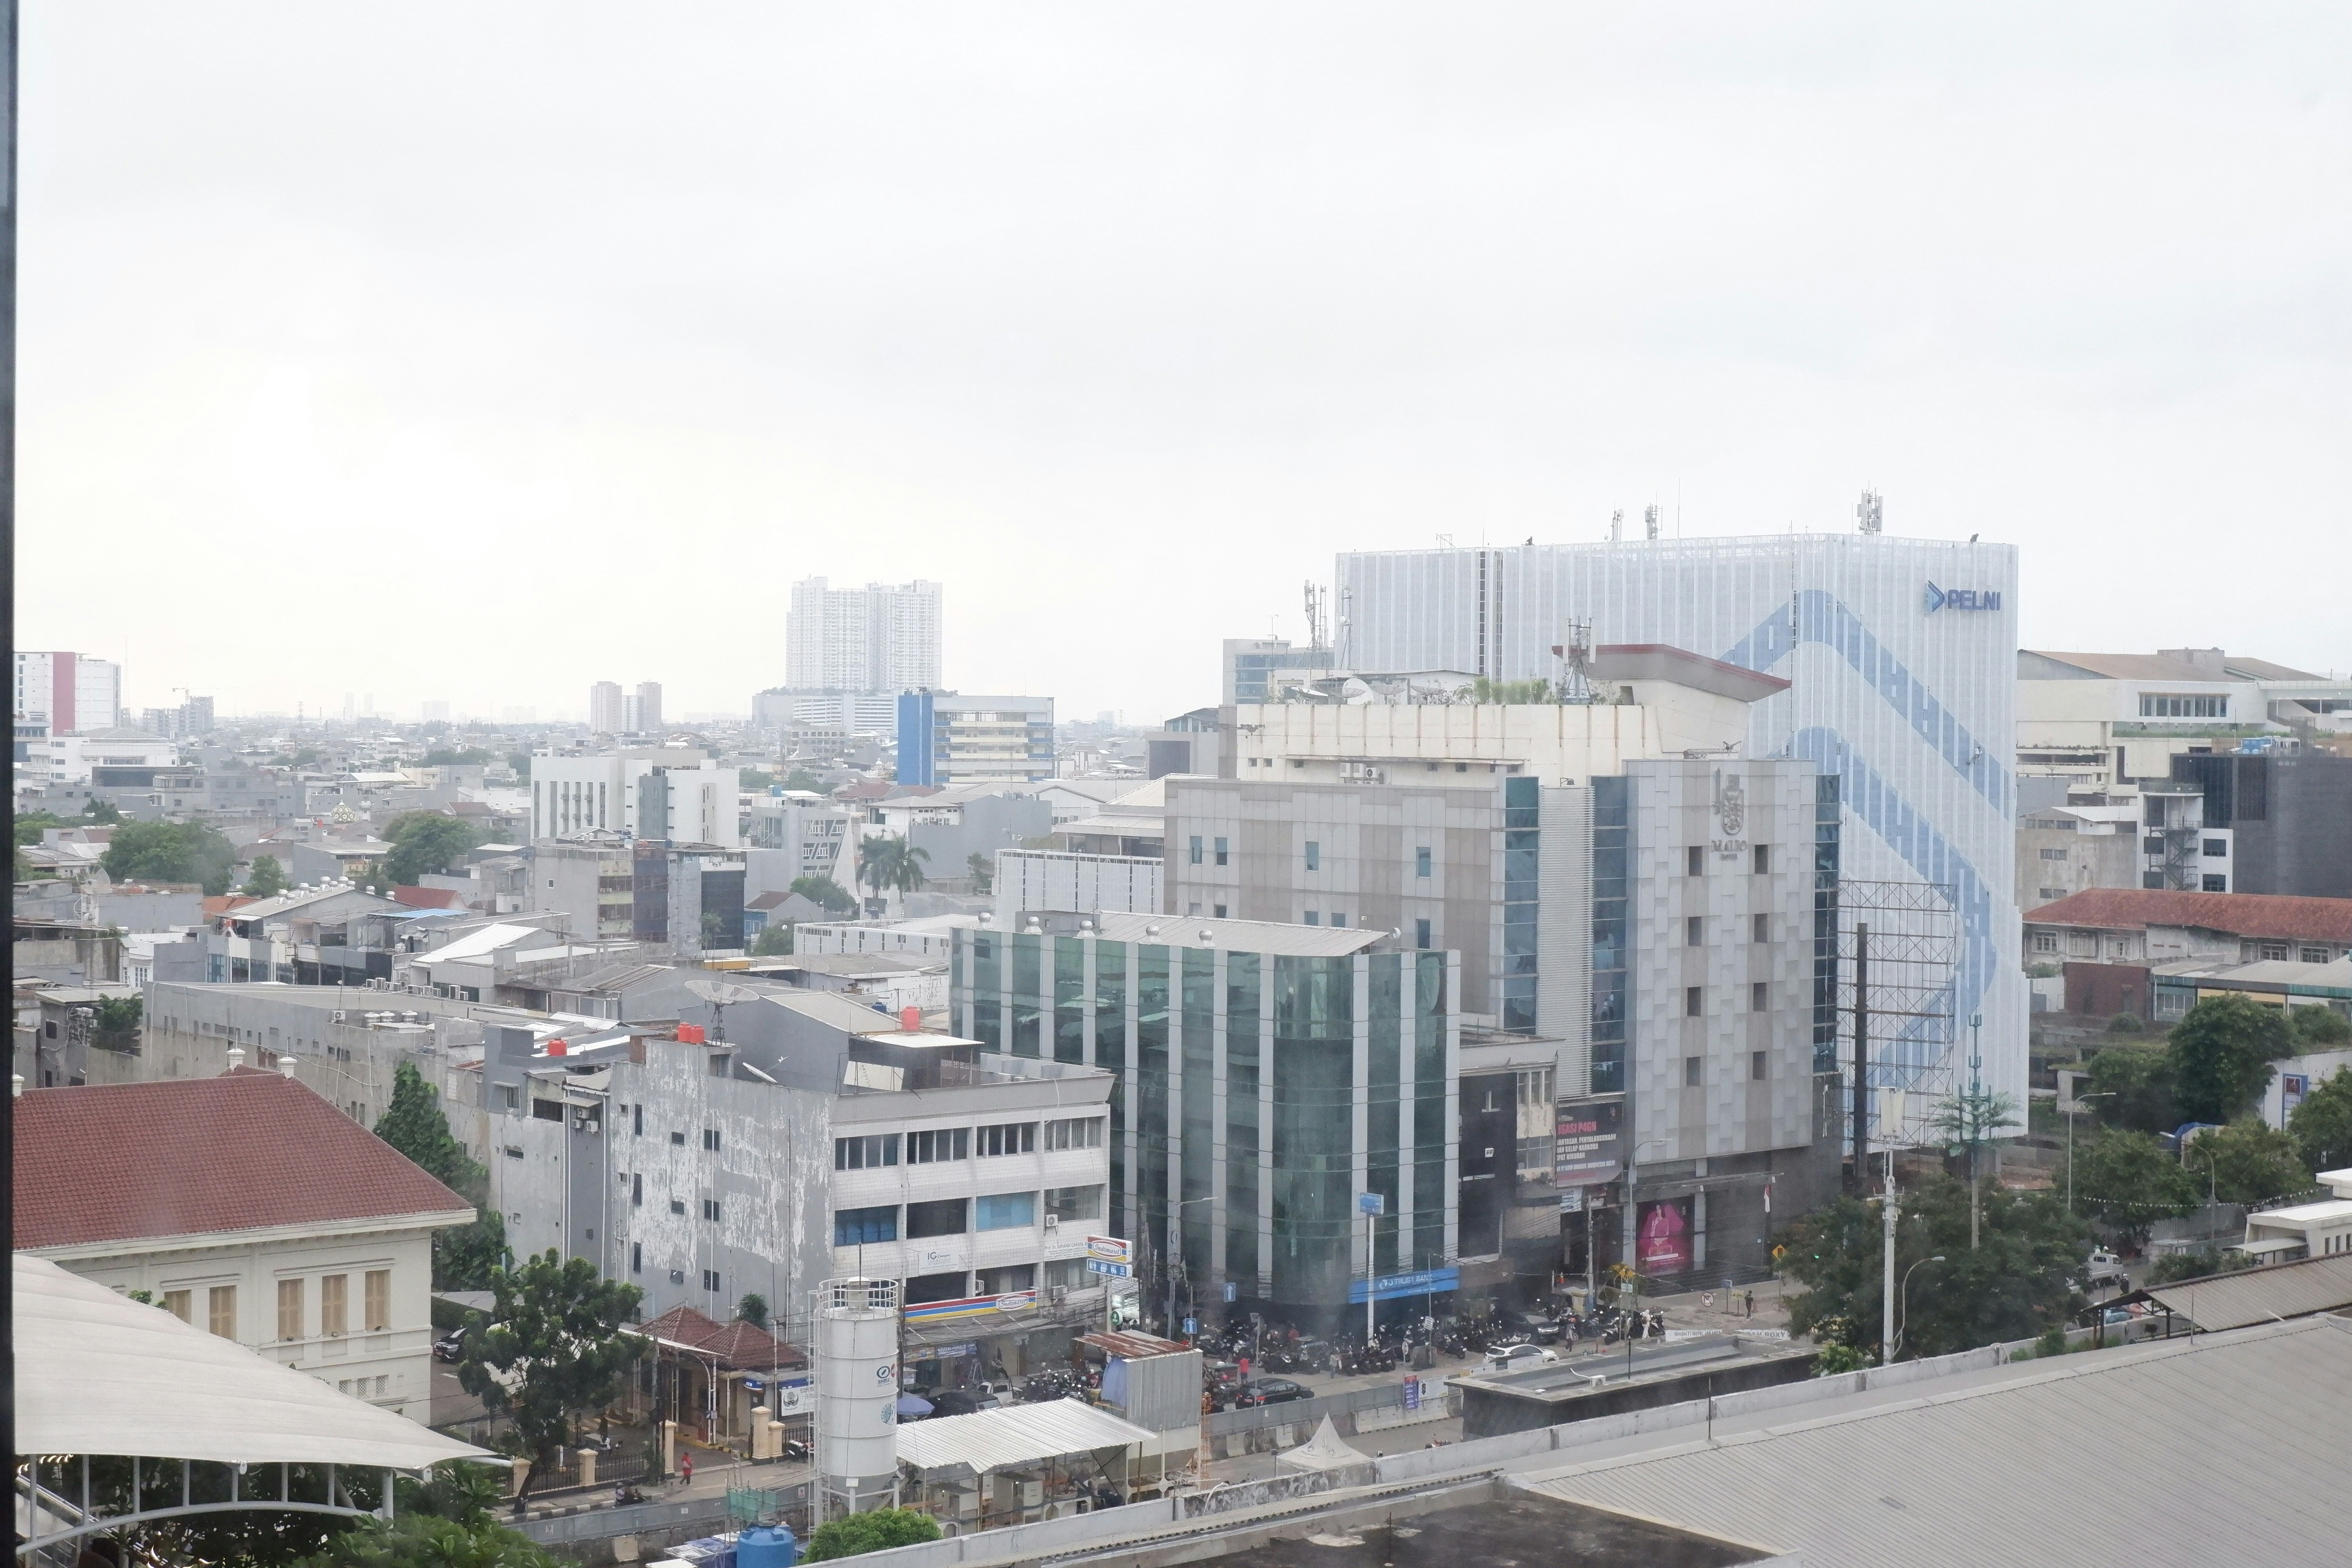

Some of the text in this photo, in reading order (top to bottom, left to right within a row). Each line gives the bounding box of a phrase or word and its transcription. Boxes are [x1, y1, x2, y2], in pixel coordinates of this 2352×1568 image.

[1947, 589, 2001, 611] PELNI
[1565, 1145, 1578, 1153] GELAP
[1579, 1143, 1599, 1151] NARKOBA
[1094, 1243, 1120, 1255] Indomaret
[927, 1252, 937, 1260] IG
[1394, 1276, 1414, 1285] TRUST
[1000, 1298, 1027, 1307] Indomaret
